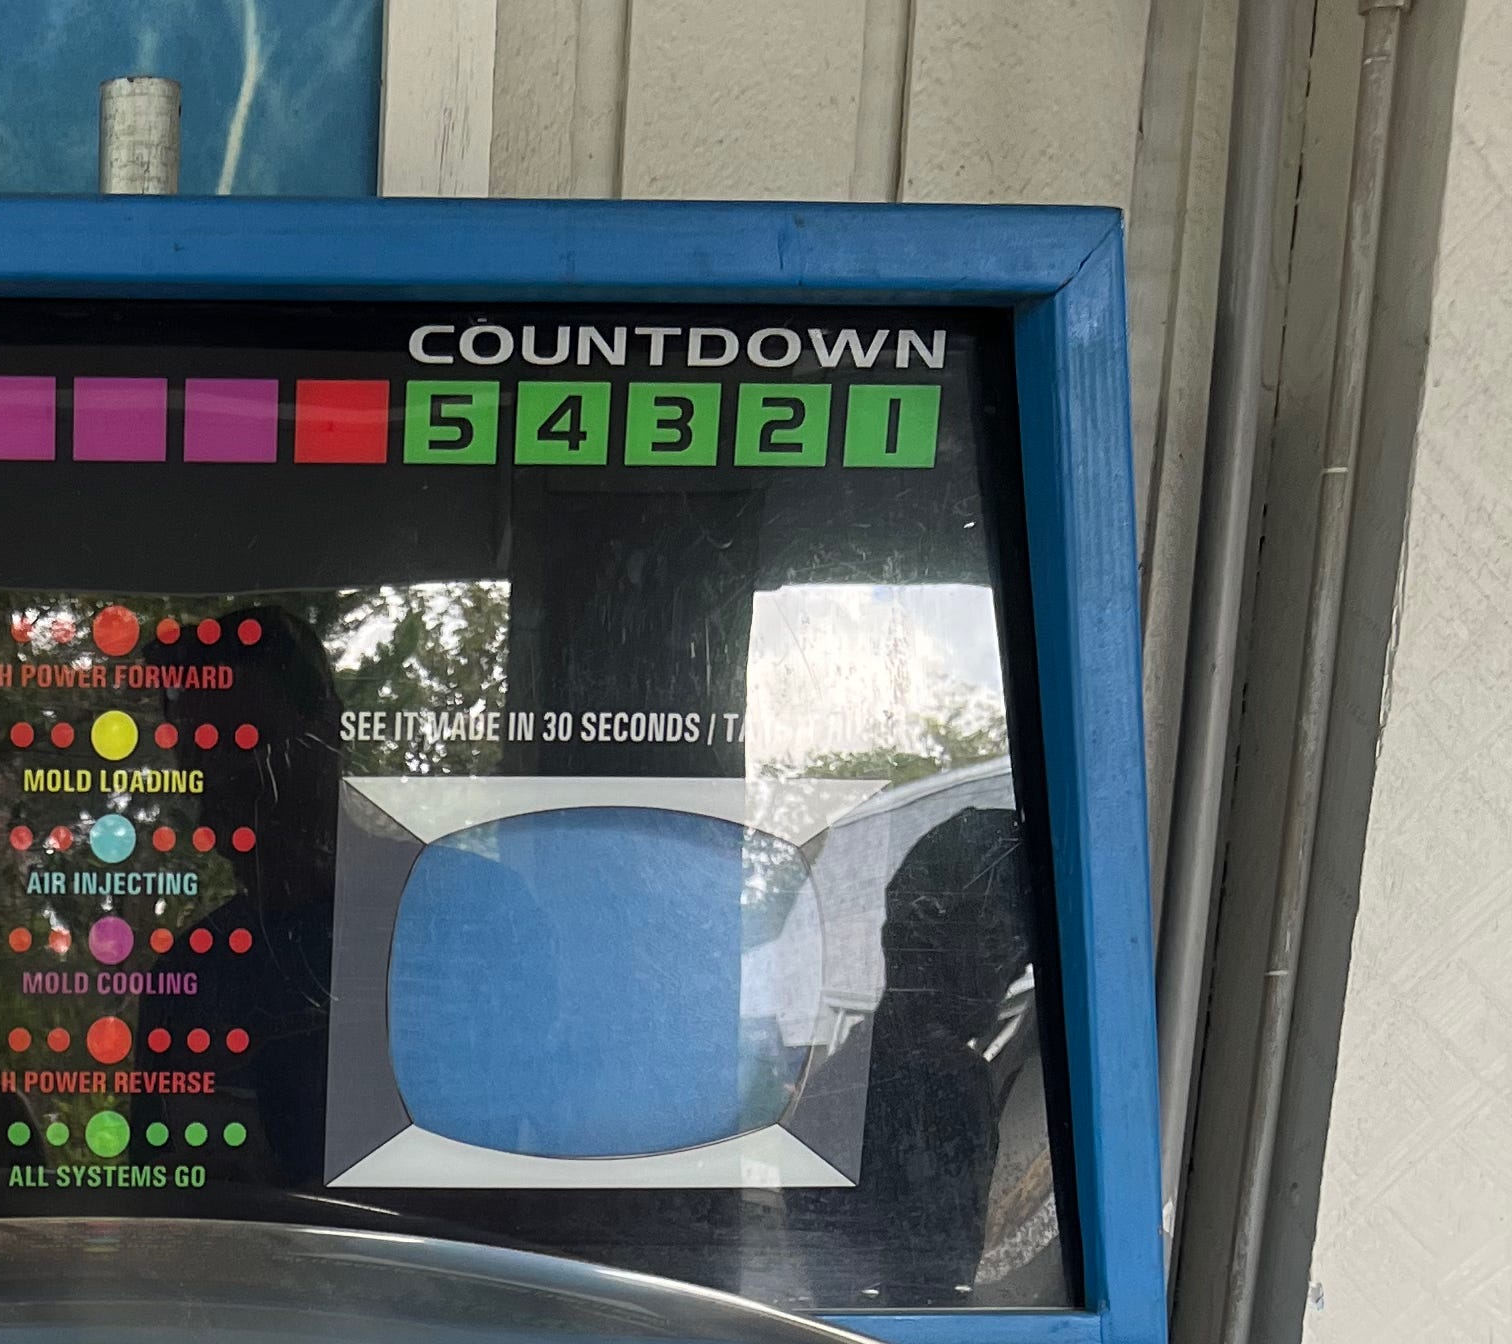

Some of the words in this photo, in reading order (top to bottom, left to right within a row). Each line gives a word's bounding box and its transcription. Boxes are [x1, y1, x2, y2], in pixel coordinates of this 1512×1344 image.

[409, 324, 947, 369] COUNTDOWN
[428, 395, 473, 450] 5
[537, 395, 586, 451] 4
[651, 396, 695, 452] 3
[759, 397, 806, 453] 2
[885, 398, 902, 454] 1
[21, 663, 106, 688] POWER
[115, 664, 234, 690] FORWARD
[339, 712, 386, 742] SEE
[393, 712, 415, 742] IT
[424, 711, 500, 742] MADE
[508, 712, 534, 742] IN
[543, 712, 573, 743] 30
[580, 711, 700, 743] SECONDS
[24, 769, 92, 793] MOLD
[100, 769, 204, 794] LOADING
[27, 872, 65, 895] AIR
[74, 872, 198, 895] INJECTING
[22, 972, 88, 994] MOLD
[97, 972, 198, 995] COOLING
[1, 1071, 15, 1093] H
[24, 1071, 106, 1093] POWER
[114, 1071, 215, 1094] REVERSE
[9, 1166, 49, 1187] ALL
[56, 1165, 166, 1187] SYSTEMS
[175, 1165, 206, 1187] GO
